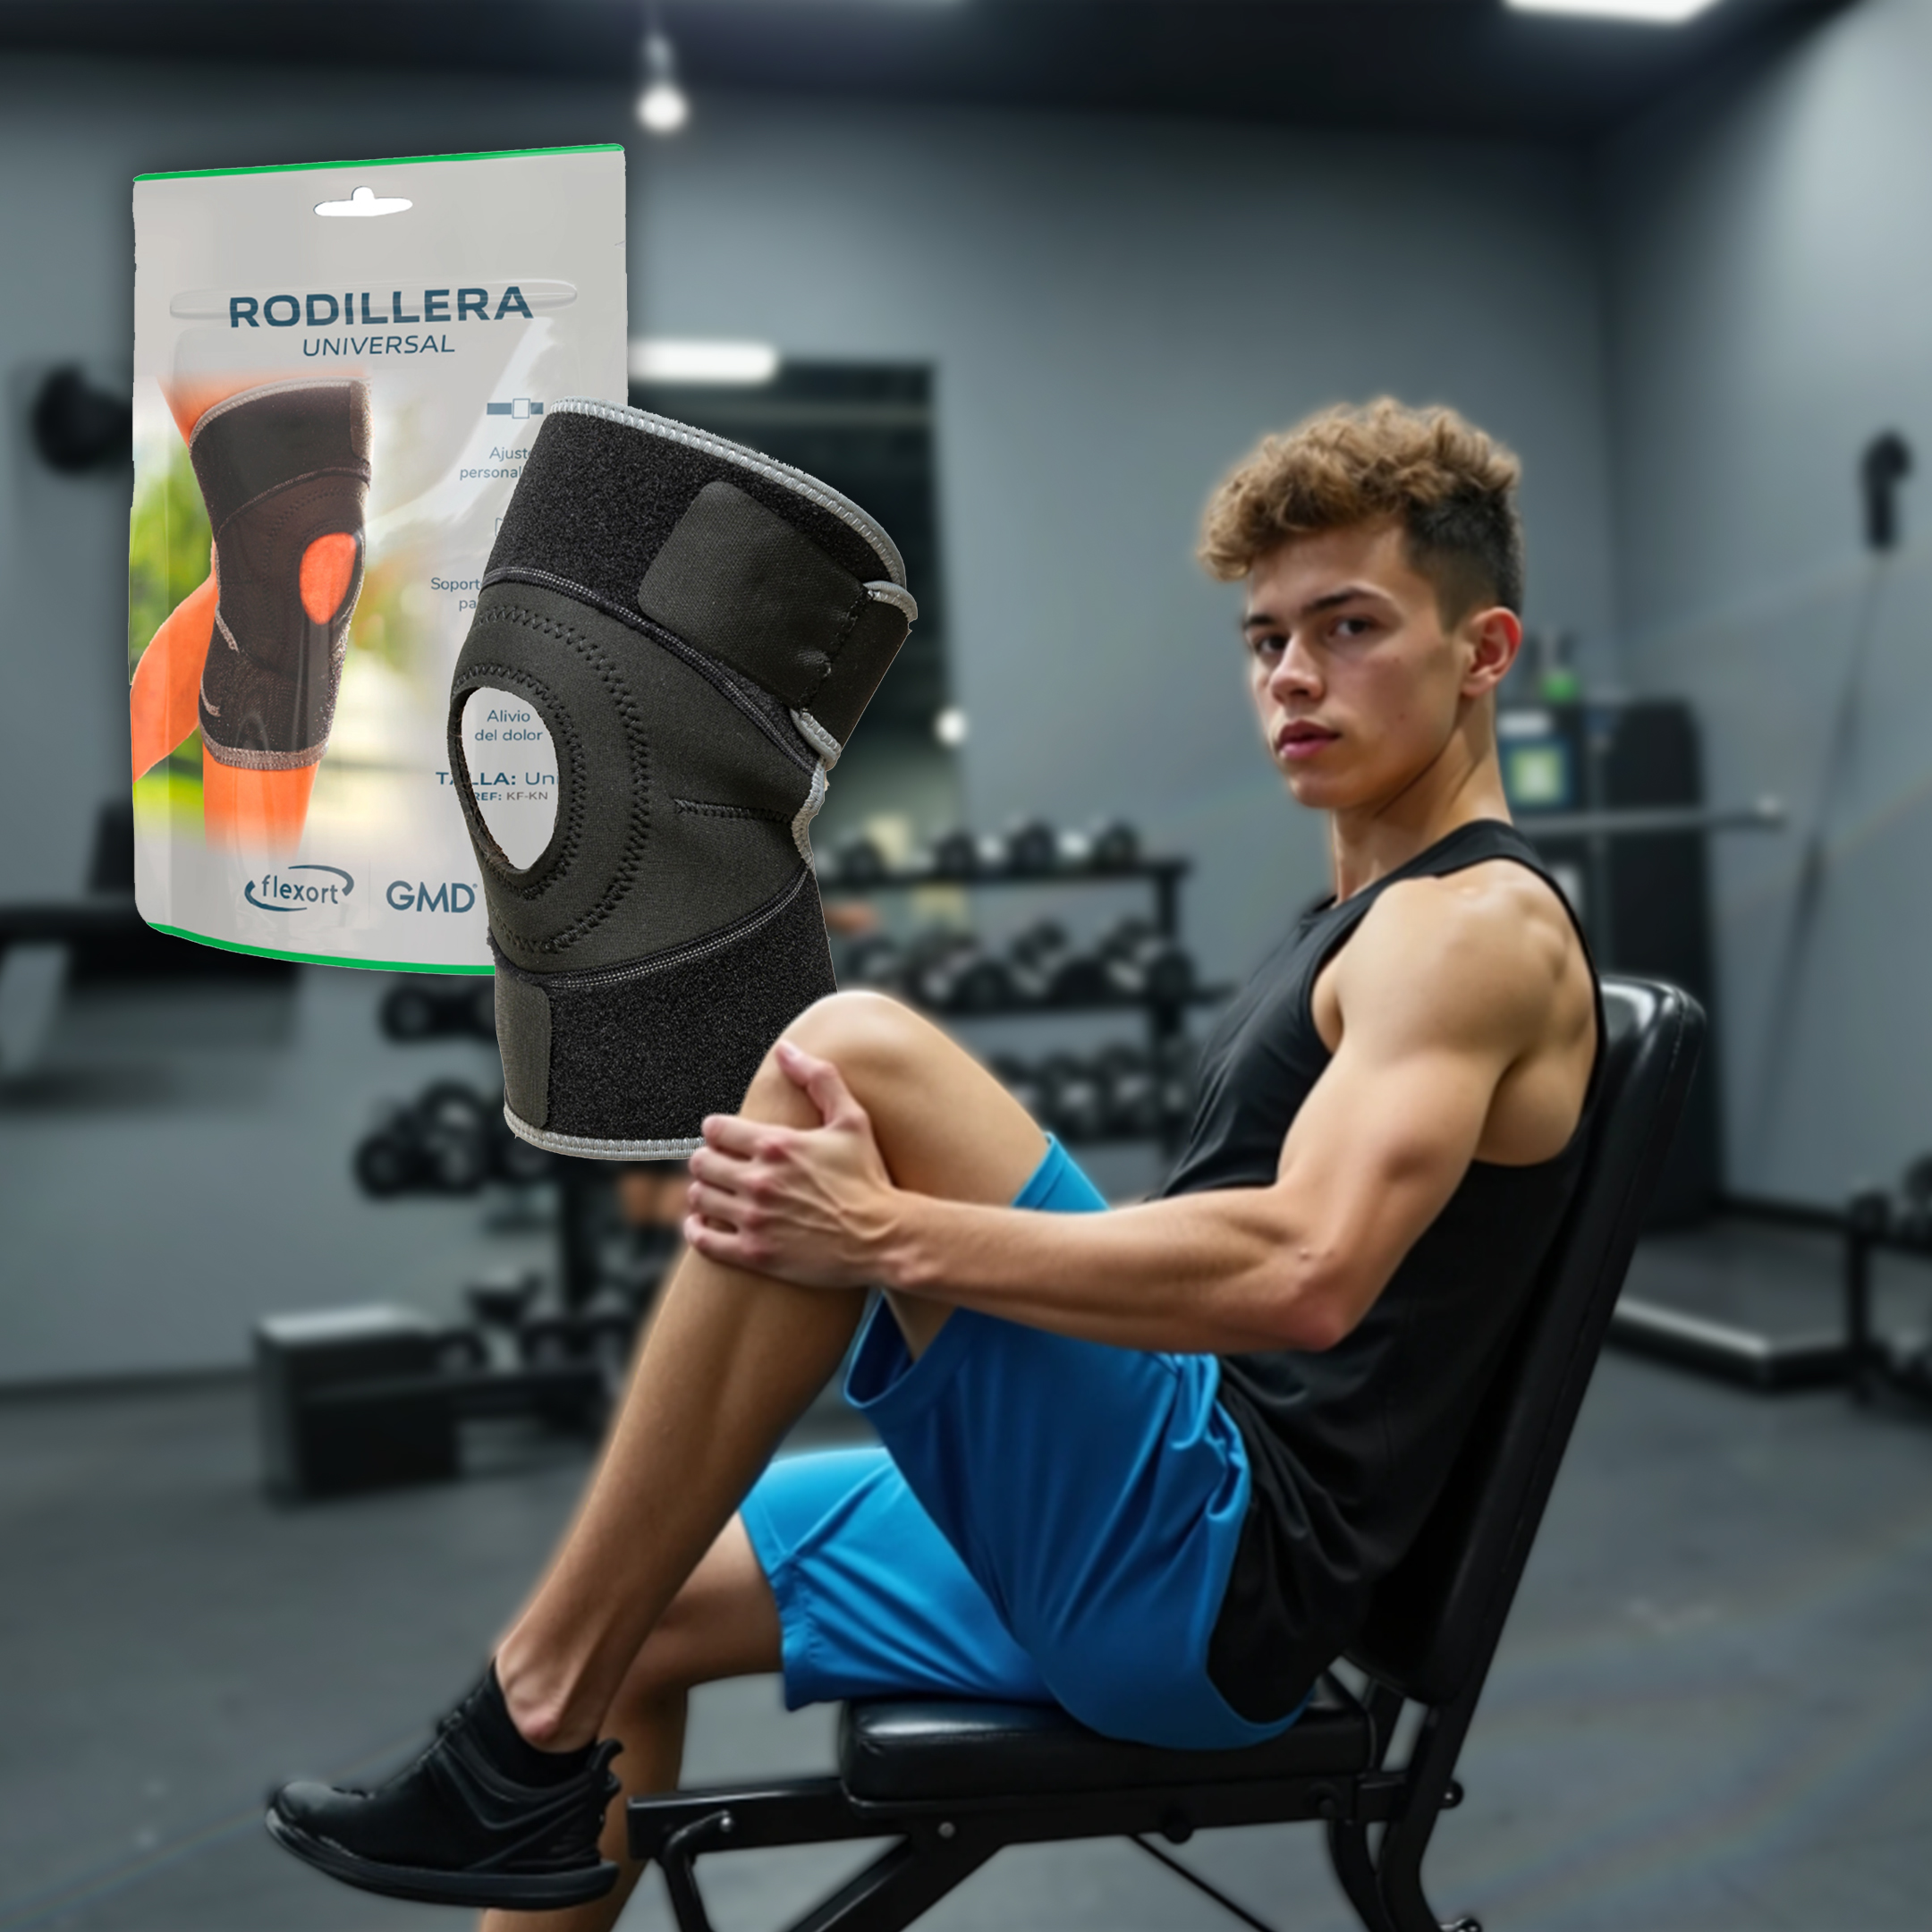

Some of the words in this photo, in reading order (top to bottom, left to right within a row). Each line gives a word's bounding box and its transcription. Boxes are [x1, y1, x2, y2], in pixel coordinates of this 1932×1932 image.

[229, 285, 535, 328] RODILLERA
[302, 334, 455, 357] UNIVERSAL
[460, 465, 521, 480] personal
[431, 577, 482, 592] Soport
[487, 709, 530, 722] Alivio
[474, 729, 497, 741] del
[502, 729, 543, 741] dolor
[436, 772, 516, 785] TLA:
[506, 792, 548, 801] KF-KN
[261, 875, 339, 904] flexort
